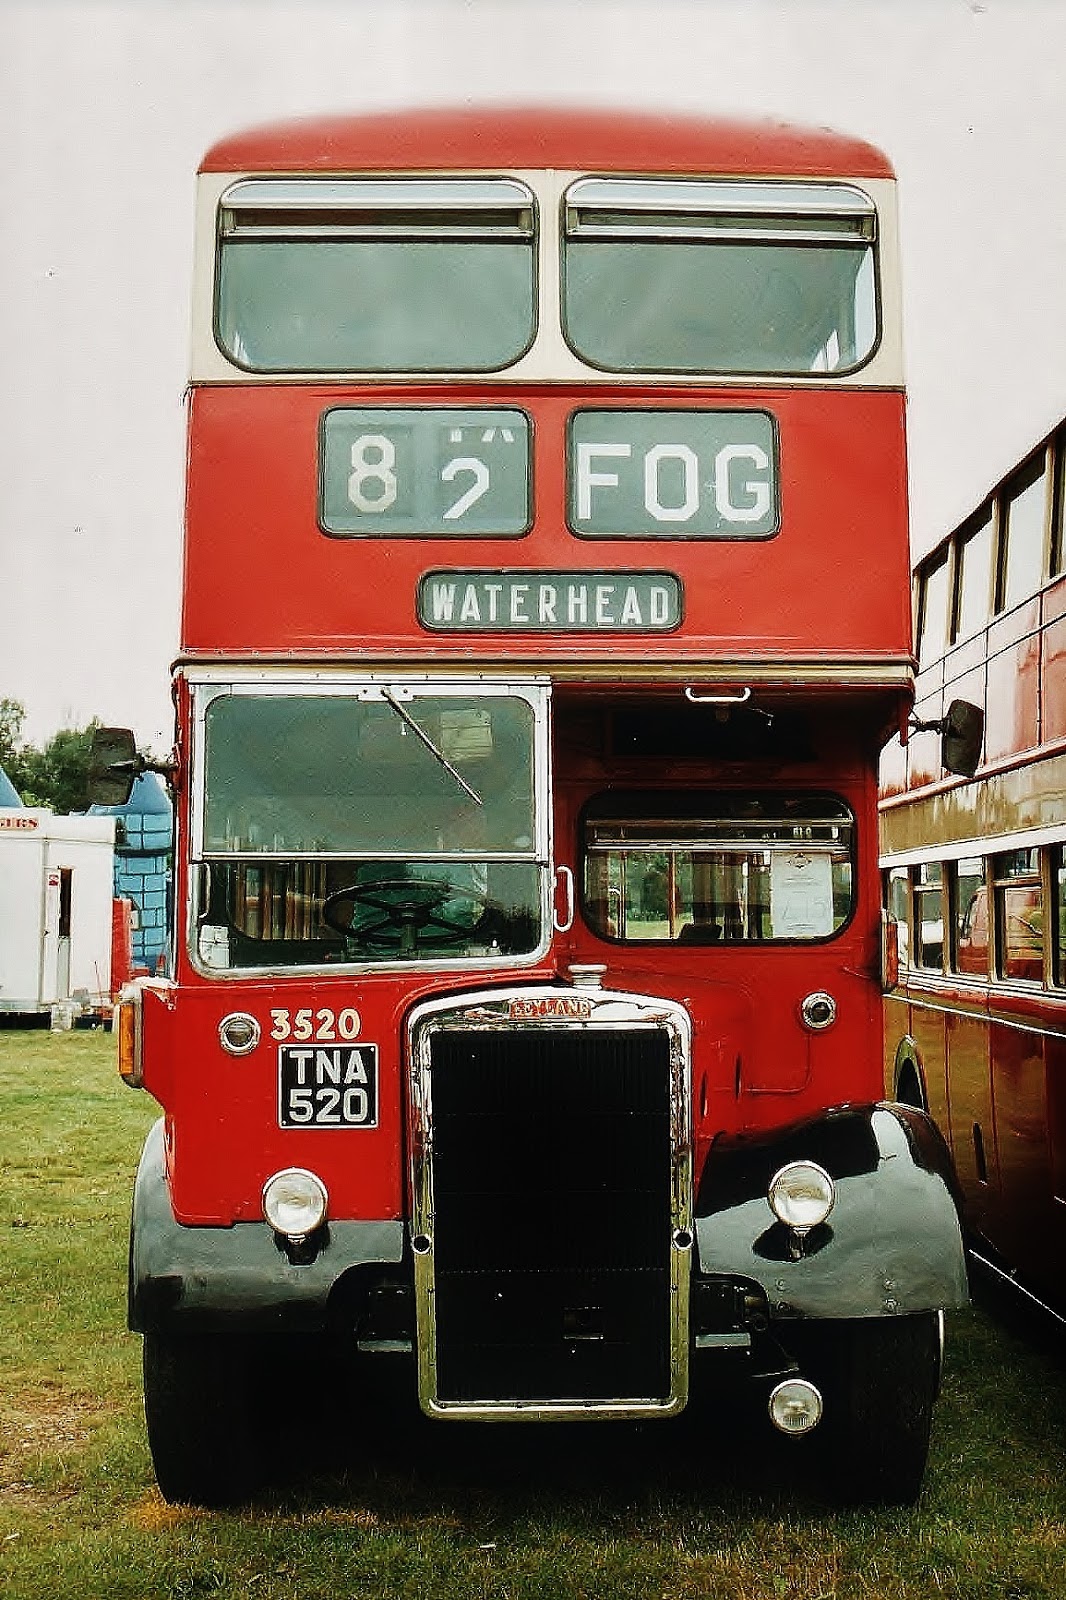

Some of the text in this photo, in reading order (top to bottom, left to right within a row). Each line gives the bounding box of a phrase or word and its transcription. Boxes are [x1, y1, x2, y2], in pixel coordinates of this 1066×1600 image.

[576, 443, 770, 522] FOG
[431, 583, 670, 626] WATERHEAD
[270, 1008, 362, 1040] 3520
[289, 1050, 368, 1084] TNA
[288, 1087, 368, 1123] 520
